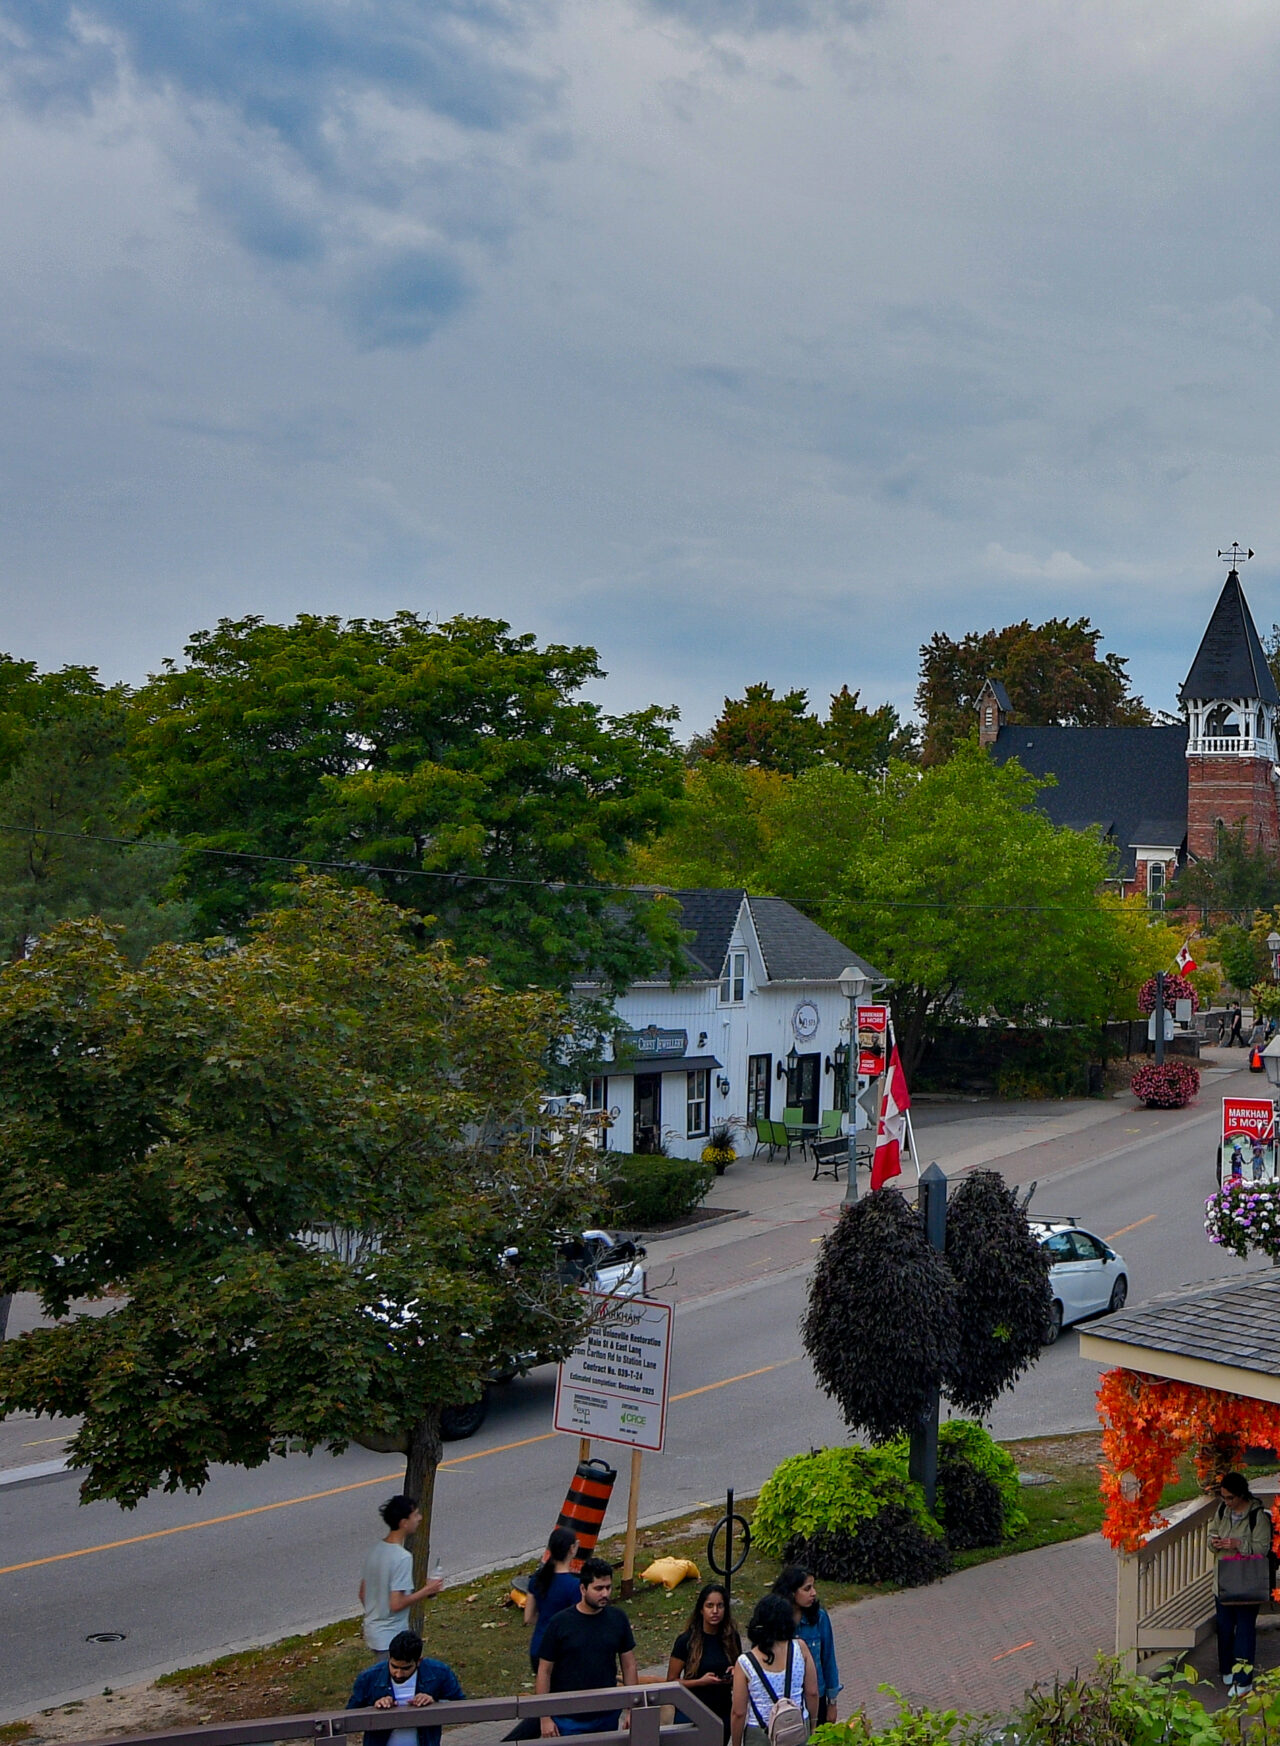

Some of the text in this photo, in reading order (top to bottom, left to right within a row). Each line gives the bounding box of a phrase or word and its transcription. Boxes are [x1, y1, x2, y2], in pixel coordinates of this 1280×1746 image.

[1228, 1108, 1269, 1119] MARKHAM
[1228, 1118, 1238, 1127] IS
[588, 1336, 601, 1347] Main
[603, 1339, 609, 1349] St
[615, 1341, 628, 1352] East
[630, 1333, 662, 1346] Restoration
[583, 1361, 607, 1374] Contract
[607, 1365, 616, 1376] No.
[607, 1352, 615, 1361] Rd
[616, 1353, 622, 1362] to
[623, 1355, 642, 1366] Station
[643, 1358, 657, 1370] Lane
[570, 1372, 592, 1383] Estimated
[618, 1381, 641, 1393] December
